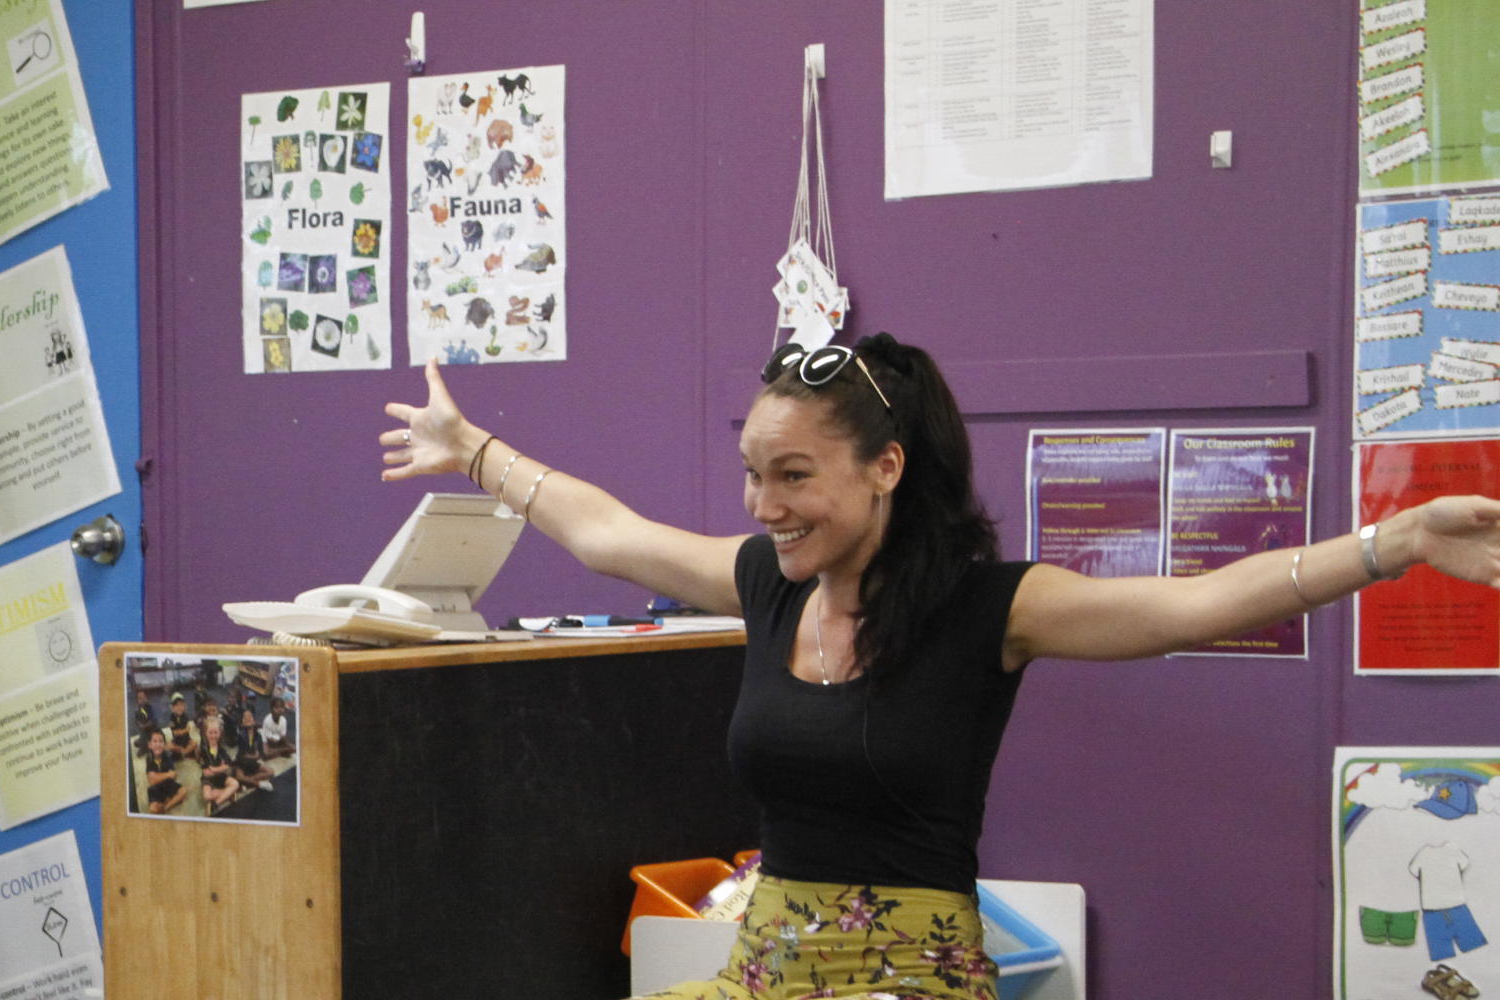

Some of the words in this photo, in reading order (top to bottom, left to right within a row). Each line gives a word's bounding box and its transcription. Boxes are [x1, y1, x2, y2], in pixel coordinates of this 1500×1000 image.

[1370, 75, 1412, 95] Brandon
[449, 197, 522, 218] Fauna
[287, 208, 344, 230] Flora
[1184, 438, 1204, 449] Our
[1206, 438, 1262, 449] Classroom
[1265, 436, 1295, 448] Rules
